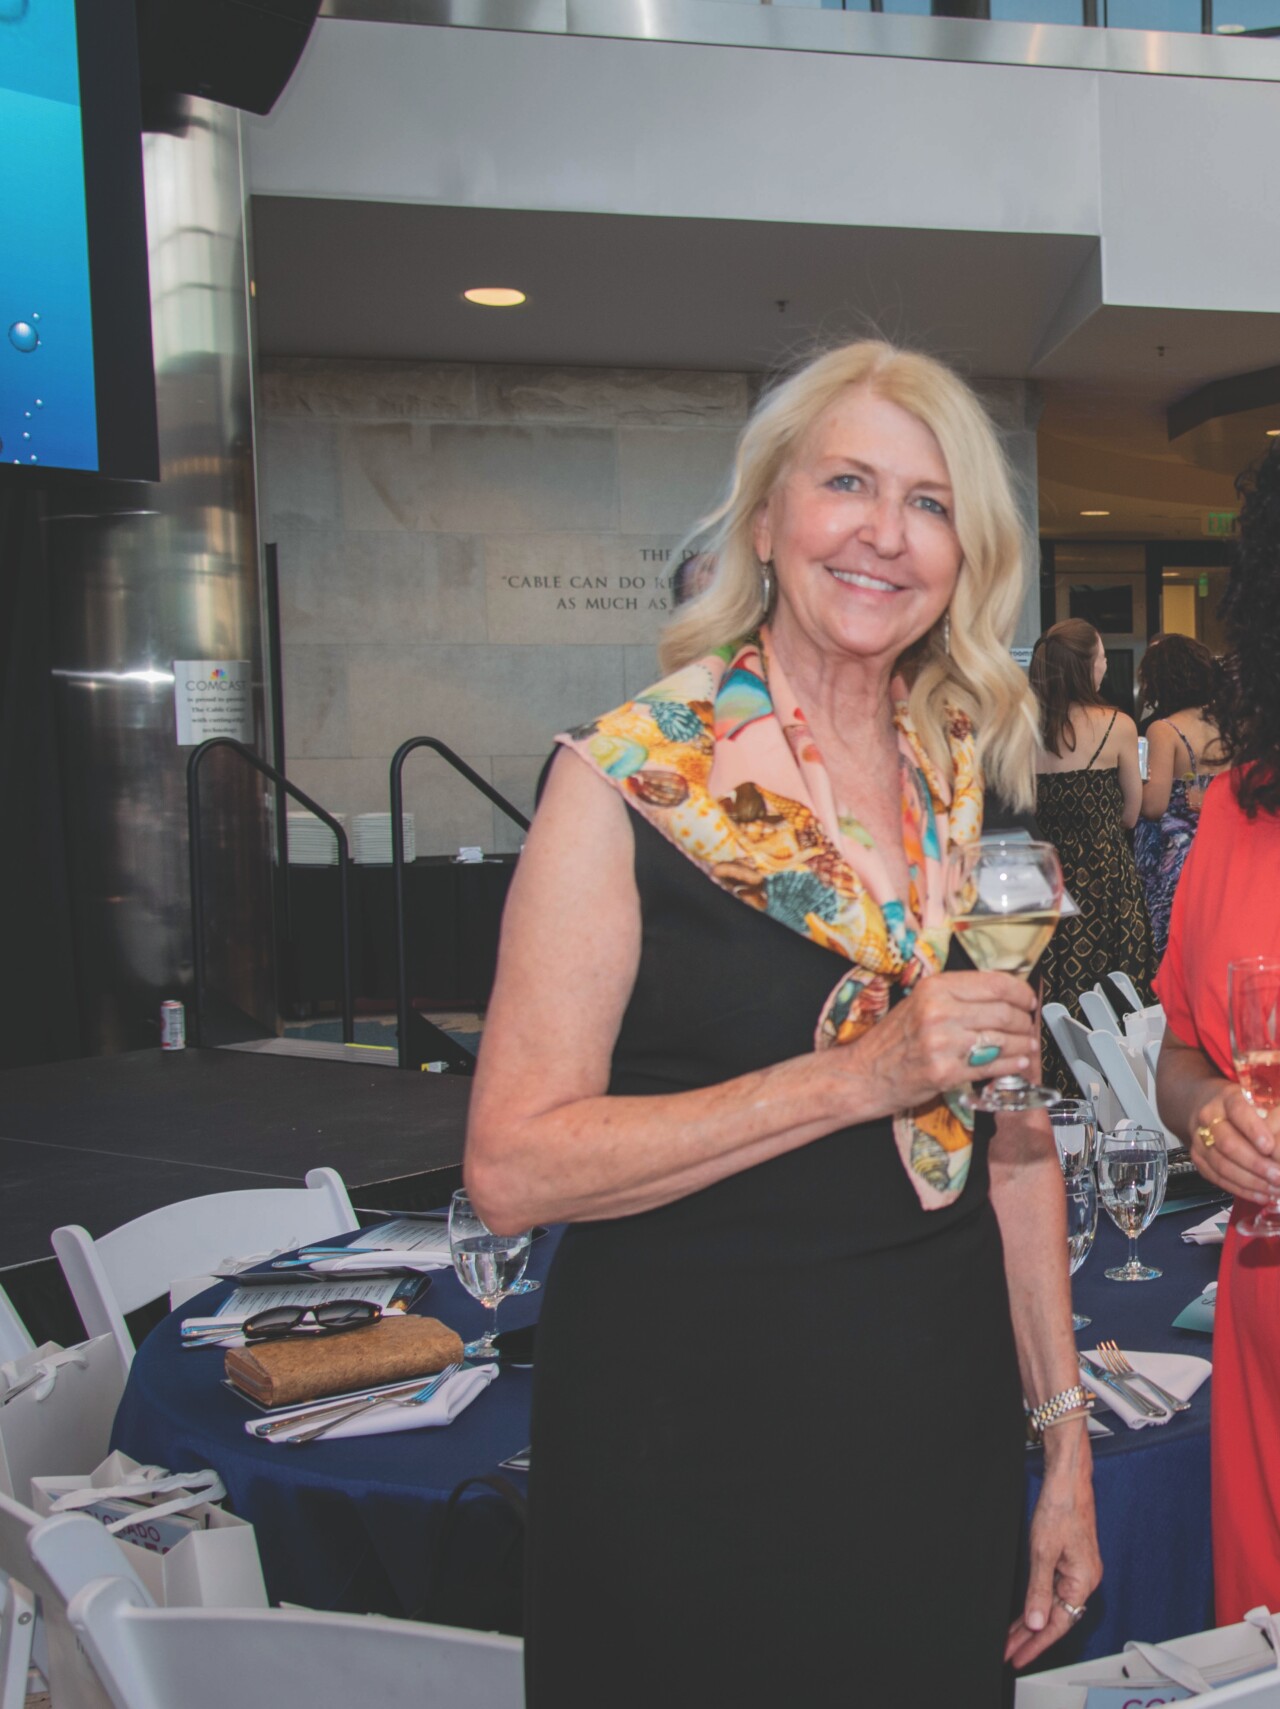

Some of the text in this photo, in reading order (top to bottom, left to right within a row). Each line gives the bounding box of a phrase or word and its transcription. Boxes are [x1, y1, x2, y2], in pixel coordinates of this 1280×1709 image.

[570, 576, 607, 589] CAN
[619, 576, 645, 589] DO
[556, 598, 576, 610] AS
[586, 598, 637, 610] MUCH
[185, 680, 246, 691] COMCAST
